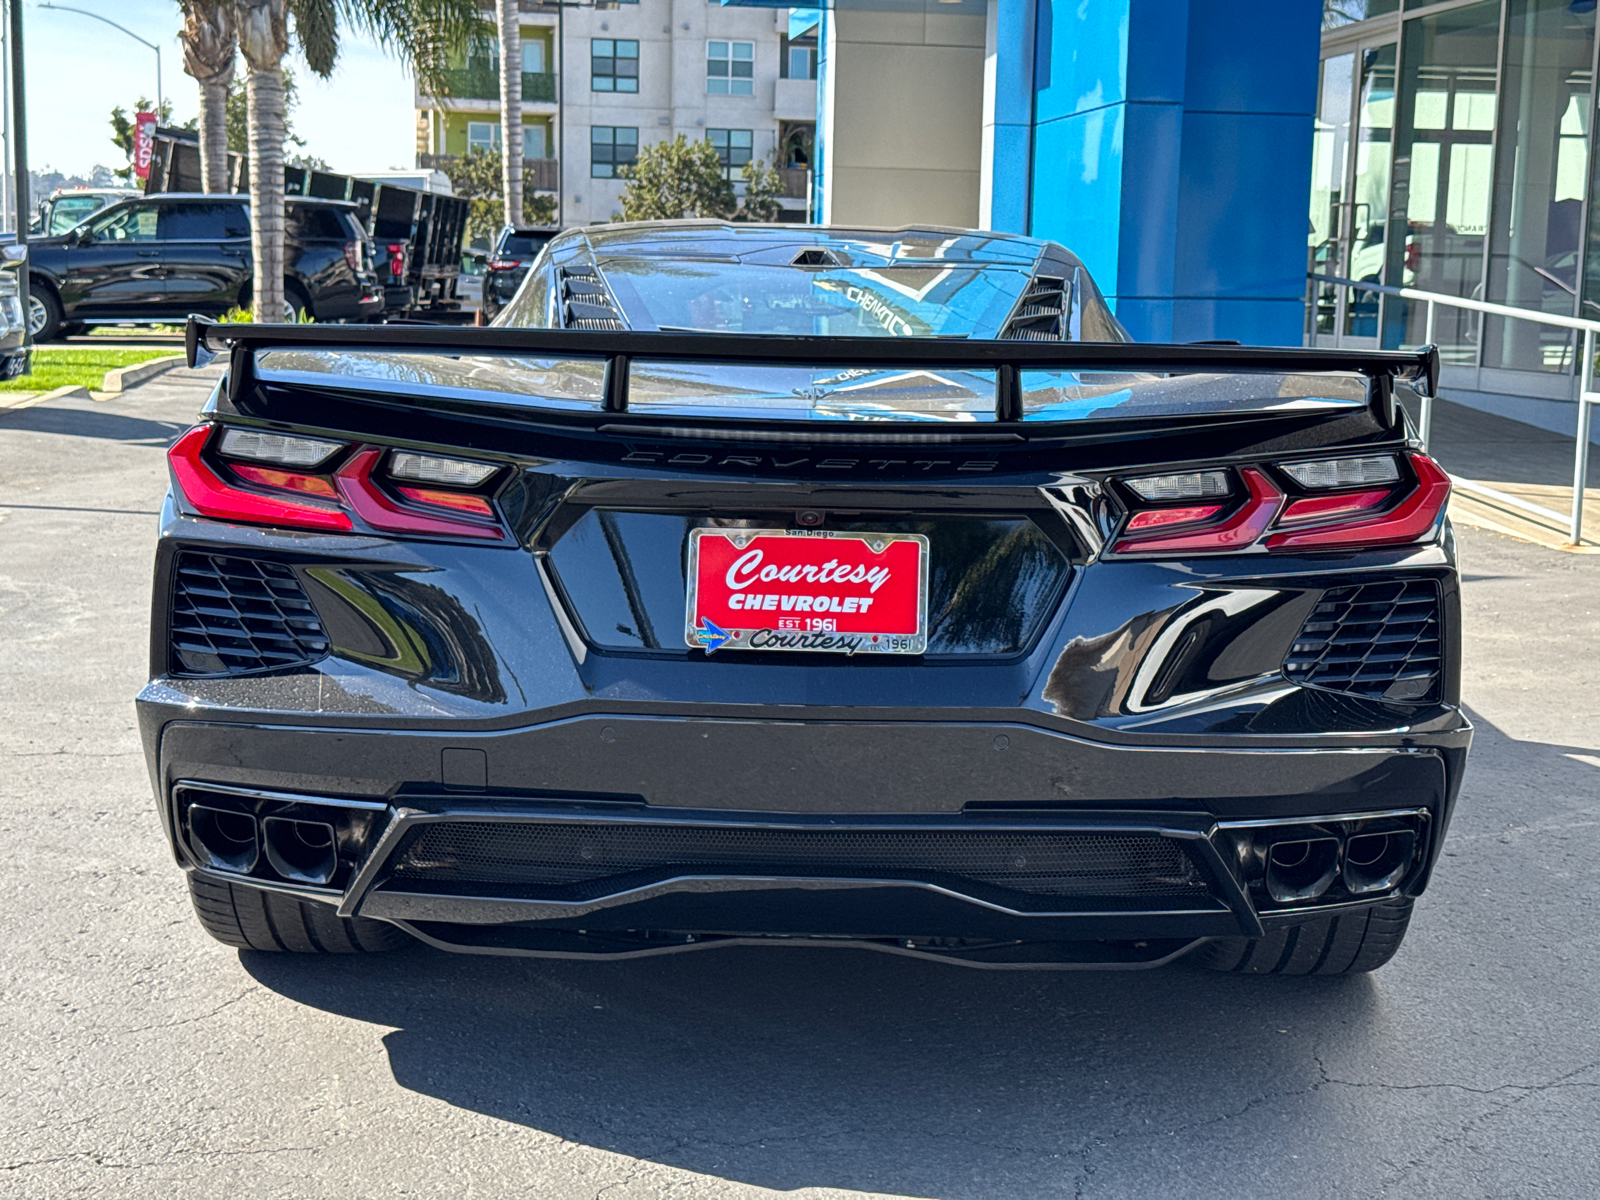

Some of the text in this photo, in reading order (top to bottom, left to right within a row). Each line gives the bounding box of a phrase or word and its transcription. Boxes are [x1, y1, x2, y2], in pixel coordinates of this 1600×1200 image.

[621, 452, 999, 471] CORVETTE
[807, 530, 834, 538] Diego
[726, 549, 891, 594] Courtesy
[728, 593, 874, 613] CHEVROLET
[778, 618, 837, 631] EST 1961
[749, 629, 863, 654] Courtesy
[886, 638, 911, 649] 1961
